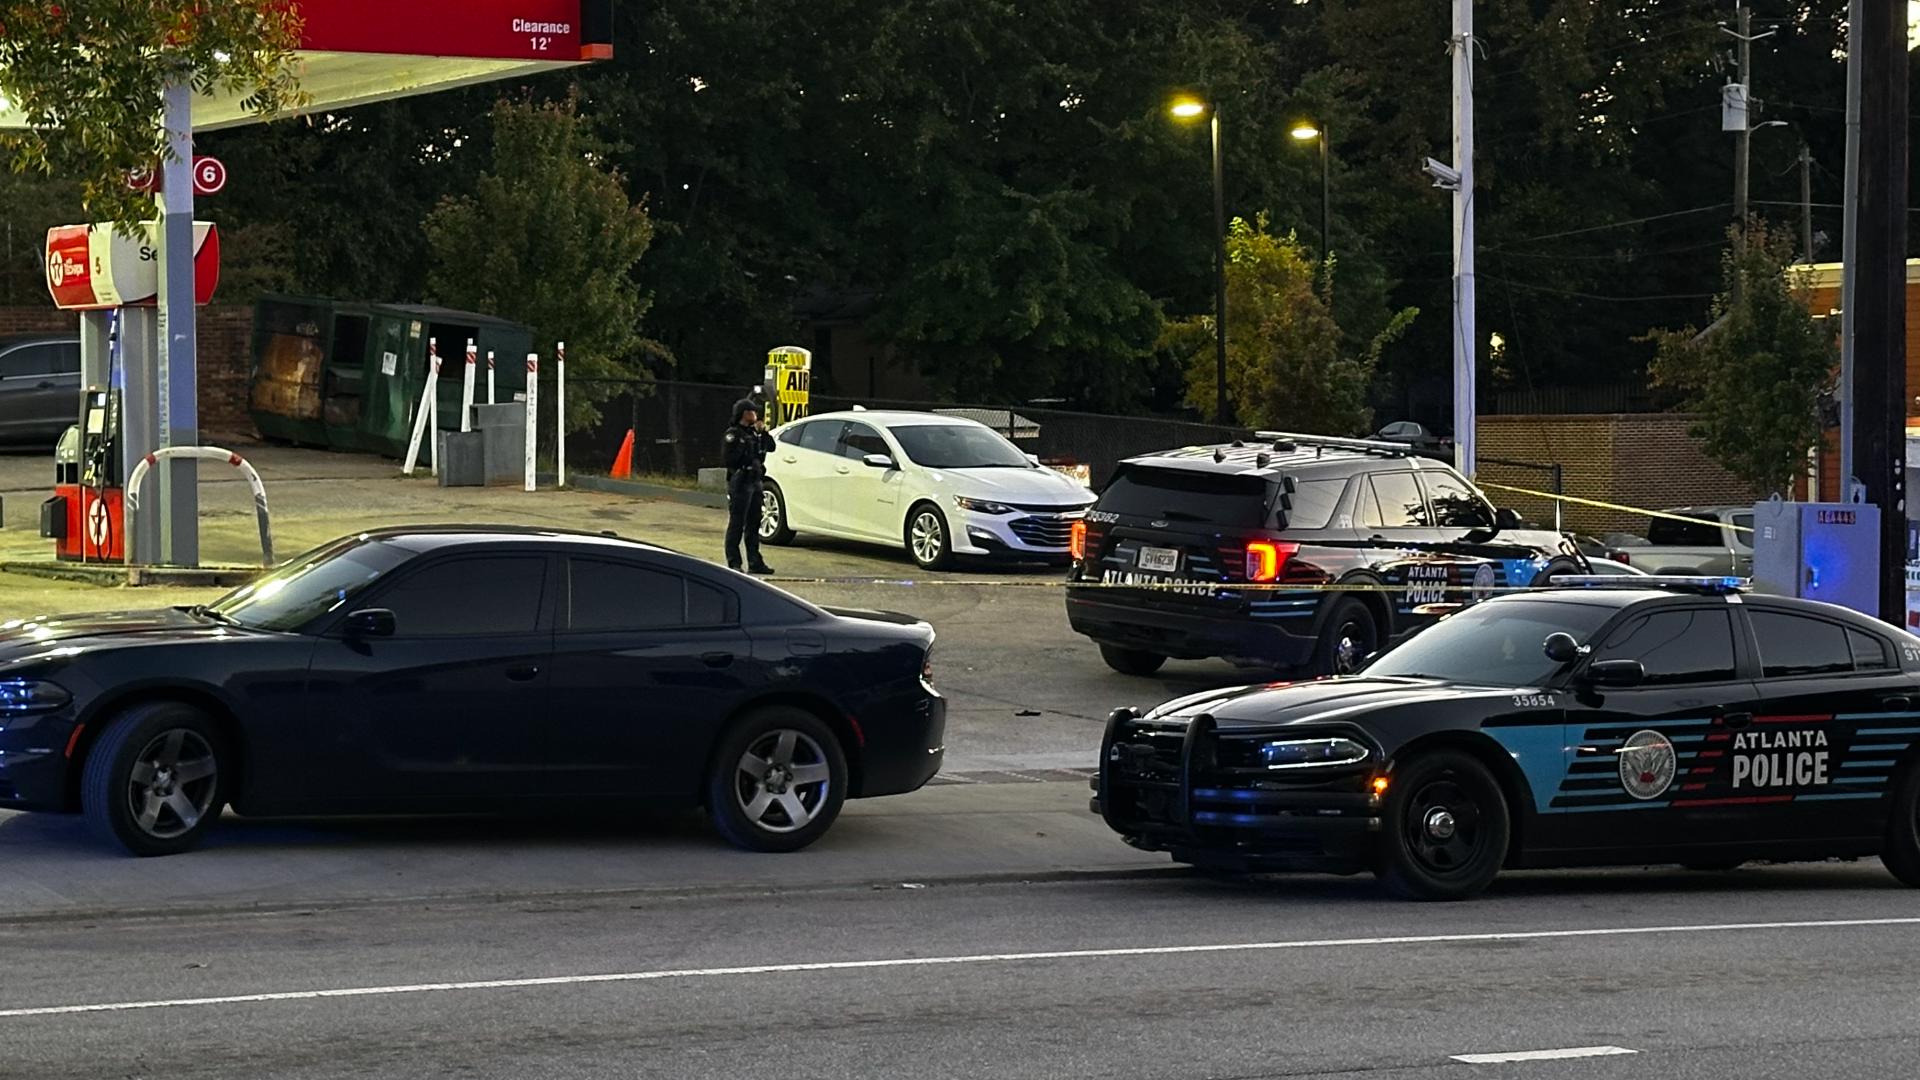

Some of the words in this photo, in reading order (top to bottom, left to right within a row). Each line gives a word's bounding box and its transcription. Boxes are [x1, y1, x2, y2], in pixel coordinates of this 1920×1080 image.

[512, 18, 570, 34] Clearance
[530, 37, 551, 51] 12'
[202, 166, 216, 183] 6
[95, 256, 101, 276] 5
[773, 353, 788, 364] VAC
[1408, 565, 1448, 578] ATLANTA
[1101, 569, 1158, 591] ATLANTA
[1163, 576, 1218, 597] POLICE
[1406, 580, 1447, 603] POLICE
[1512, 694, 1555, 707] 35854
[1733, 730, 1829, 750] ATLANTA
[1732, 751, 1830, 789] POLICE
